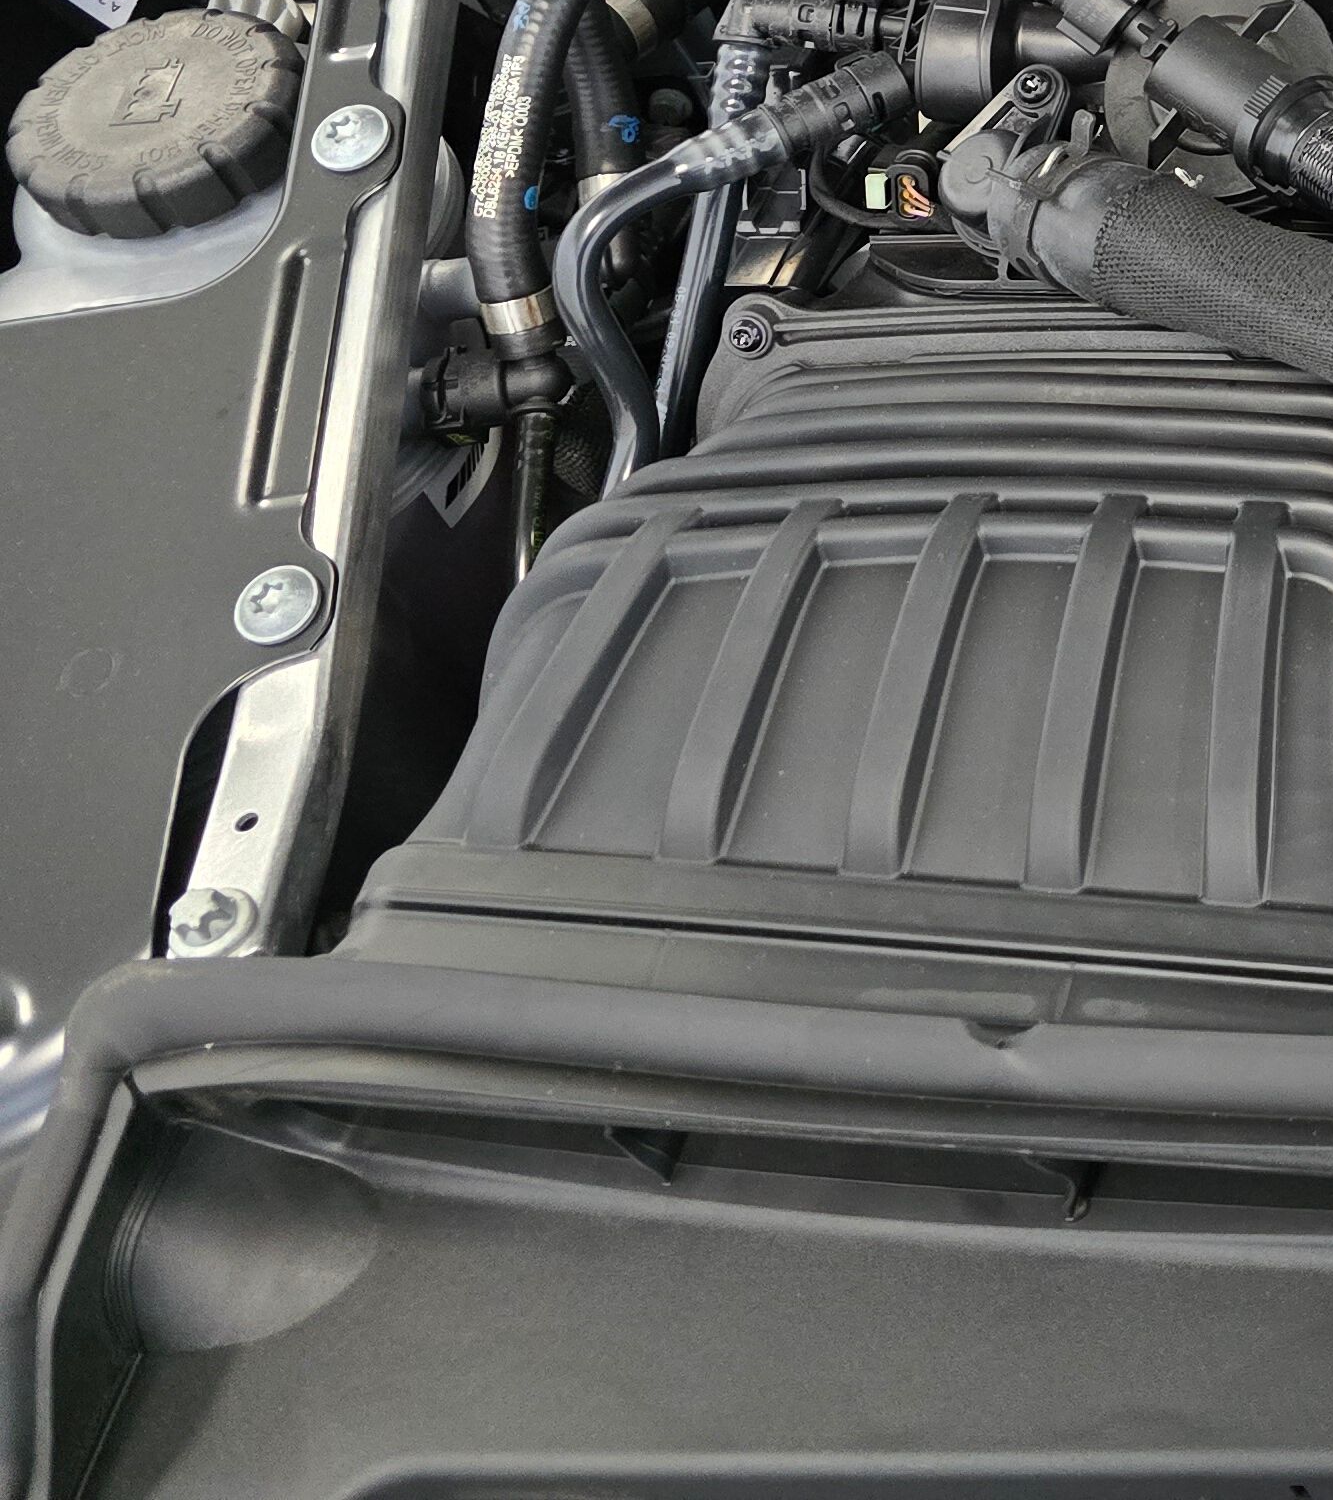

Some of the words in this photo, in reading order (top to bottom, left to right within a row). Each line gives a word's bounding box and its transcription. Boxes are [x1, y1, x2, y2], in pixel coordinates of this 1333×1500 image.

[111, 1, 121, 13] A
[191, 22, 219, 39] DO
[223, 32, 254, 57] NOT
